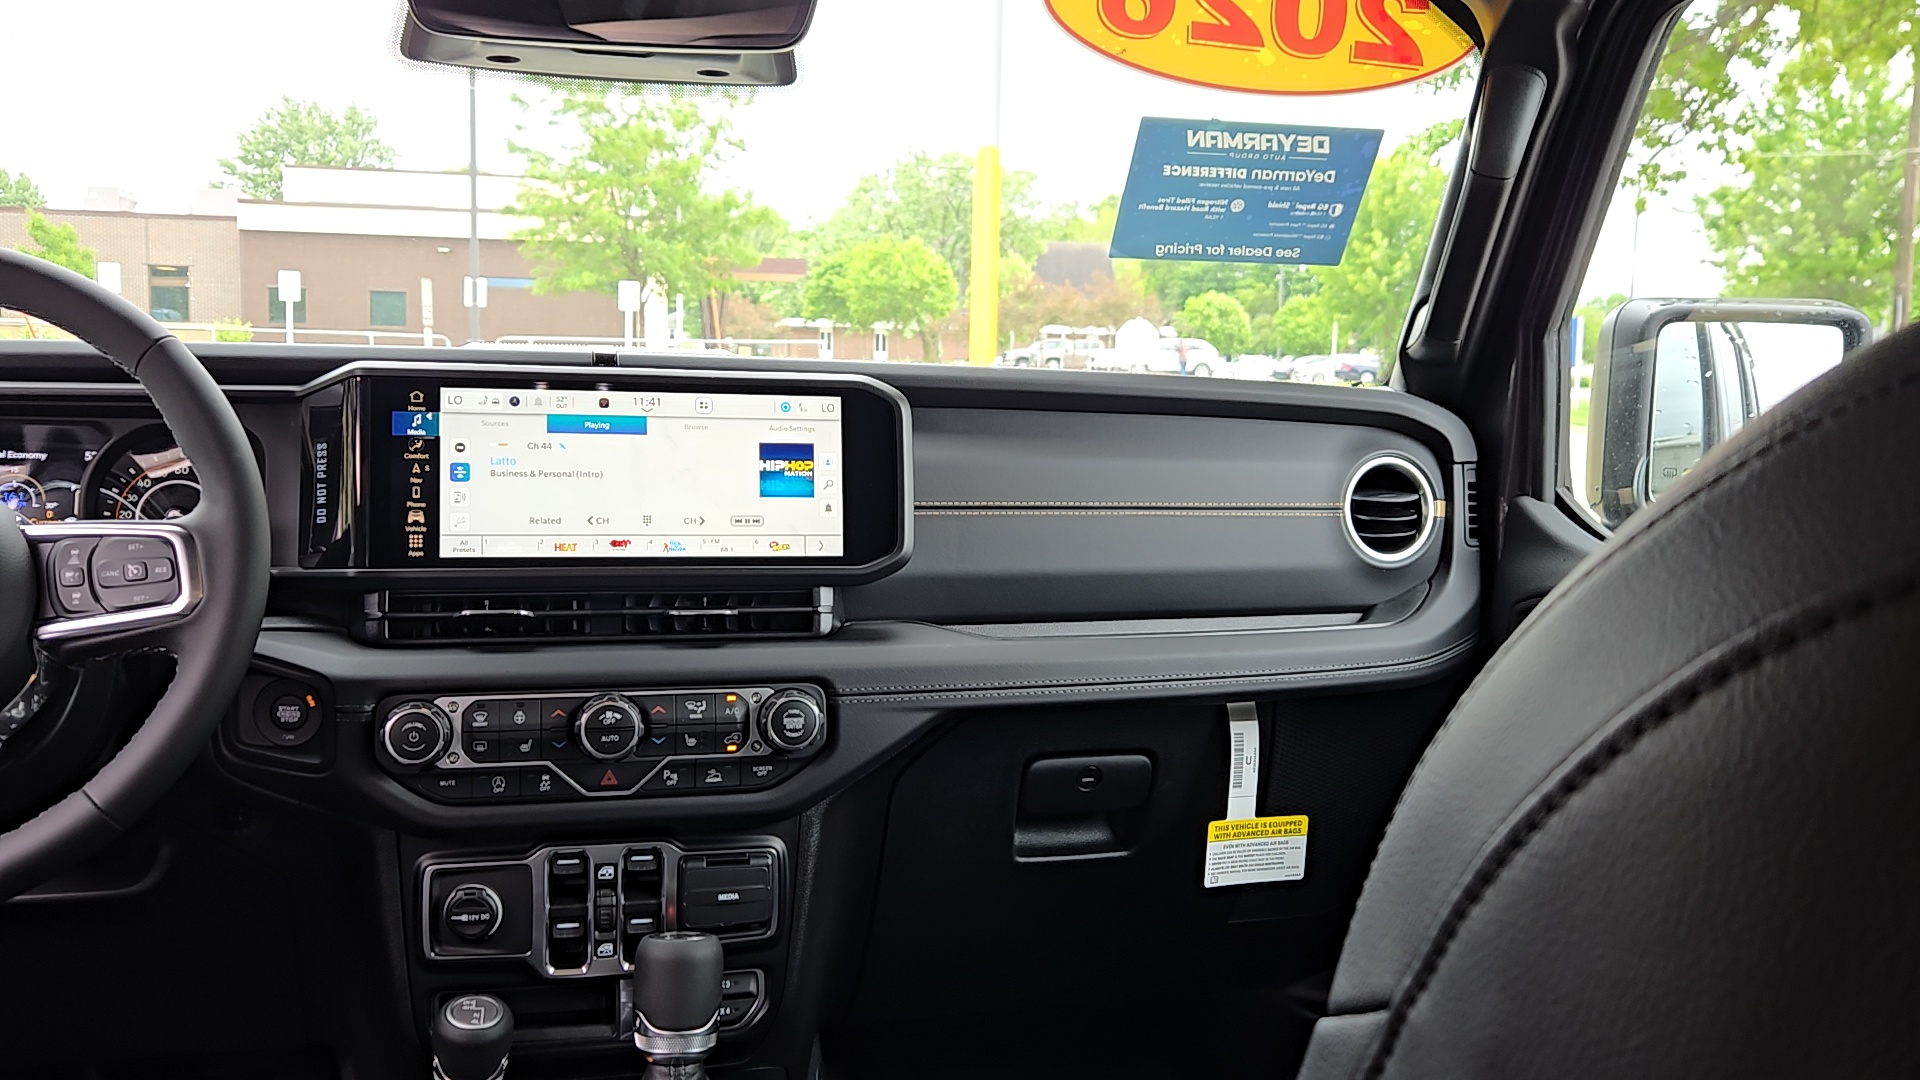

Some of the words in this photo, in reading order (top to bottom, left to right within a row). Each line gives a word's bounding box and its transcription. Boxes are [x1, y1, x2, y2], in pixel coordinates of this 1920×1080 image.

[447, 395, 463, 405] LO
[632, 397, 662, 407] 11:41
[821, 404, 835, 413] LO
[584, 421, 610, 430] Playing
[789, 425, 816, 433] Settings
[527, 442, 539, 450] Ch
[540, 442, 552, 450] 44
[7, 450, 49, 462] Economy
[316, 442, 328, 479] PRESS
[404, 452, 430, 460] Comfort
[490, 456, 517, 466] Latto
[490, 470, 528, 478] Business
[530, 470, 537, 478] &
[538, 470, 575, 479] Personal
[576, 470, 604, 479] (Intro)
[316, 483, 328, 504] NOT
[118, 510, 133, 519] 20
[316, 508, 327, 524] DO
[529, 517, 562, 525] Related
[596, 517, 610, 525] CH
[684, 517, 697, 525] CH
[554, 543, 578, 552] HEAT
[408, 550, 424, 558] Apps
[725, 707, 740, 715] A/C
[1230, 822, 1259, 831] VEHICLE
[1268, 820, 1303, 828] EQUIPPED
[1213, 832, 1231, 840] WITH
[1232, 829, 1270, 838] ADVANCED
[718, 893, 739, 901] MEDIA
